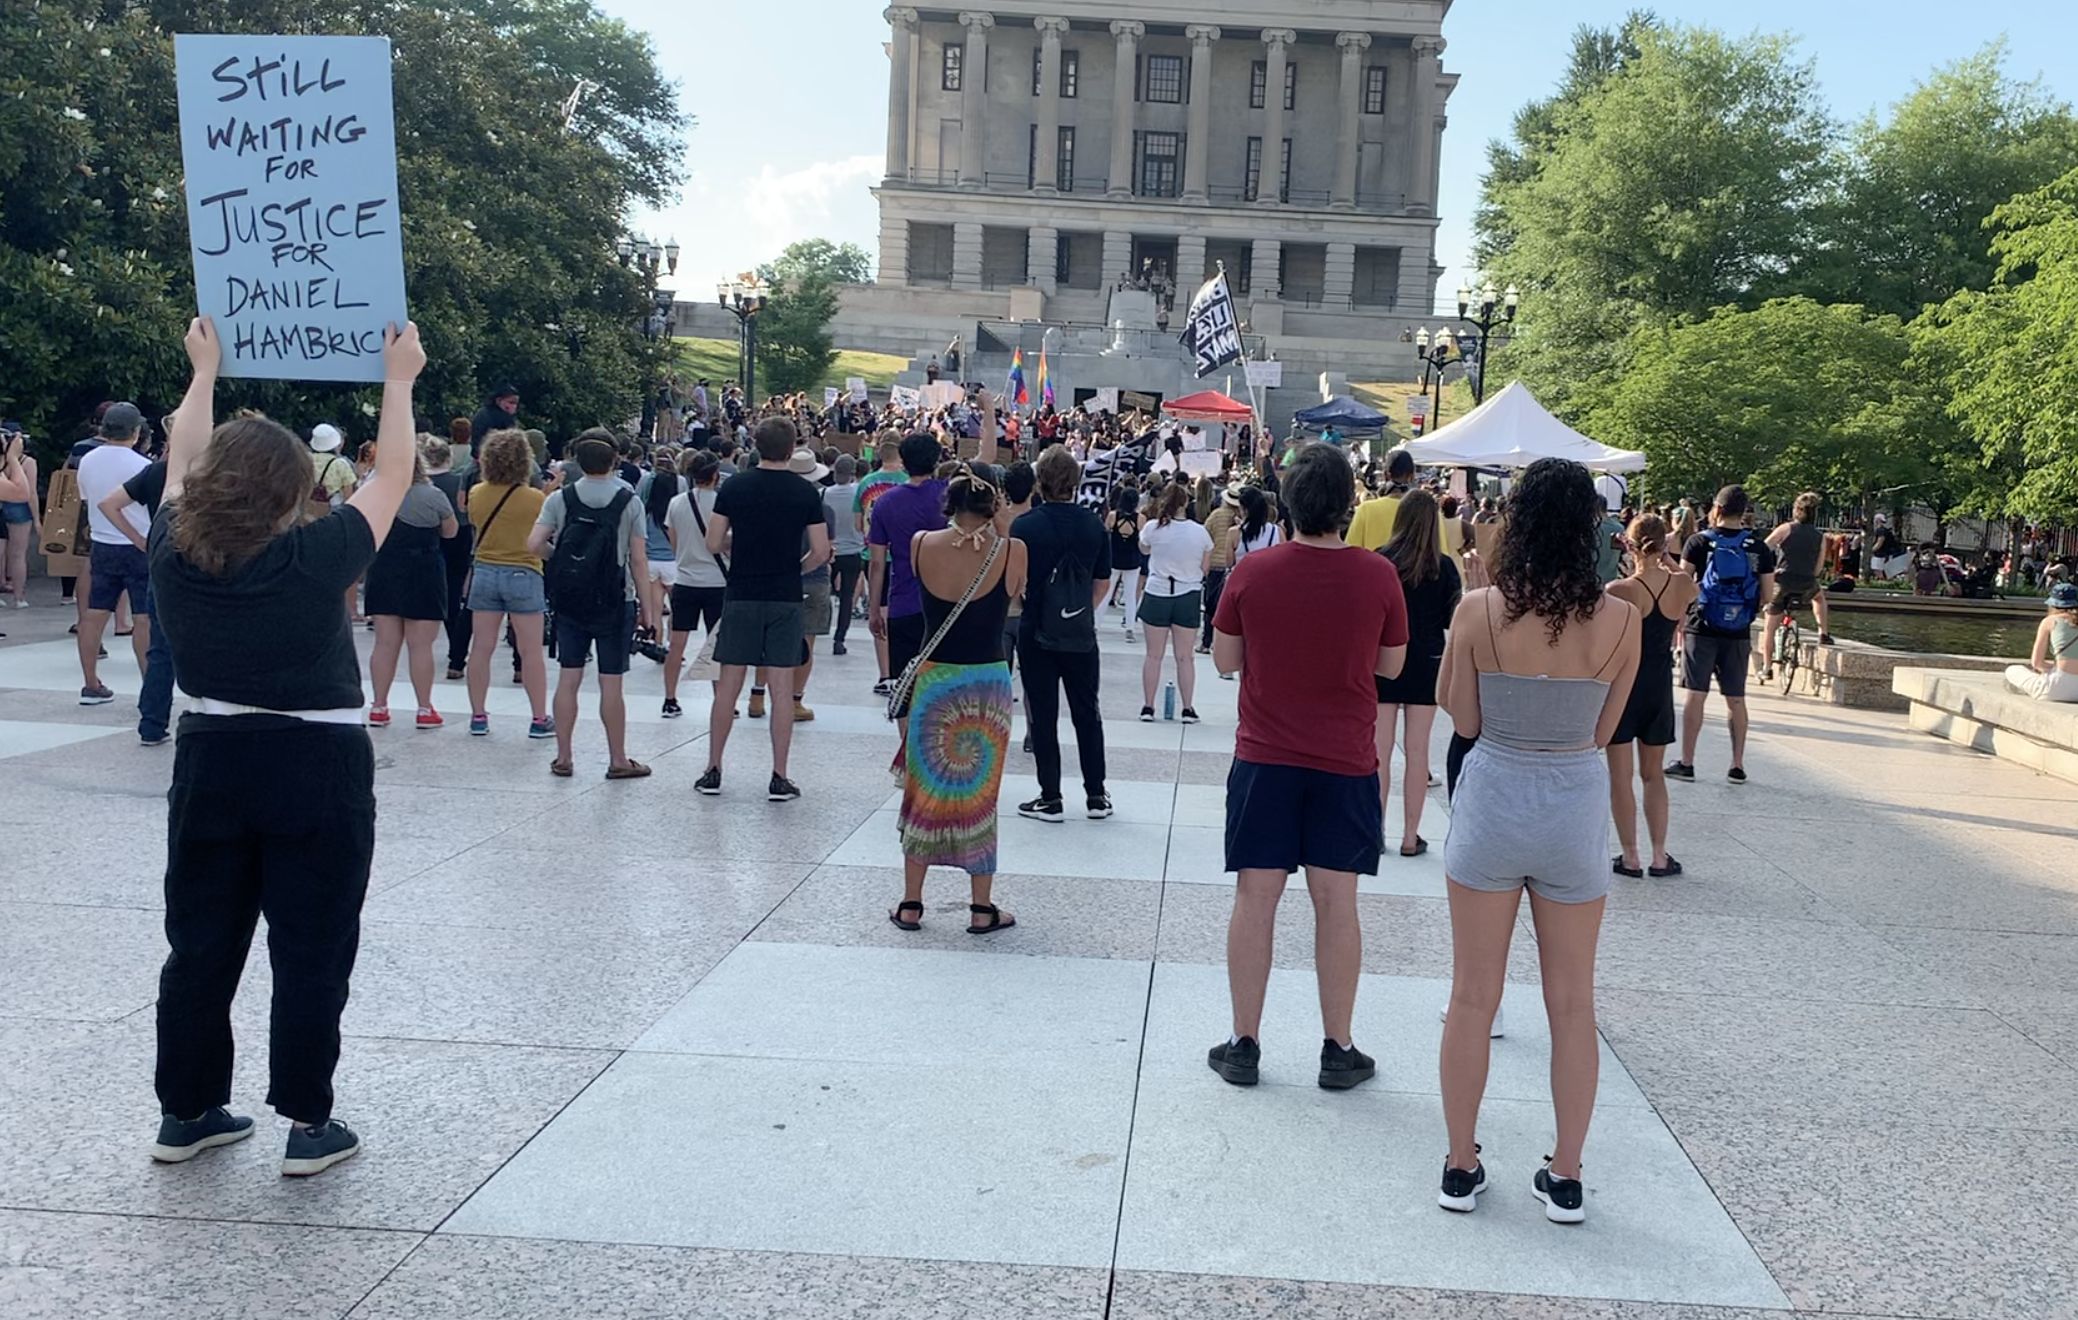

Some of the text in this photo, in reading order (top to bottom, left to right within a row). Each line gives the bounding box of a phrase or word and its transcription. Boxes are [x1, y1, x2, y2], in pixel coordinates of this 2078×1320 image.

[208, 114, 367, 157] WAITING
[265, 155, 318, 184] FOR
[198, 188, 387, 256] JUSTICE
[272, 243, 334, 272] FOR
[224, 276, 370, 318] DANIEL
[234, 322, 388, 361] HAMBRIC
[1111, 445, 1145, 486] BLA
